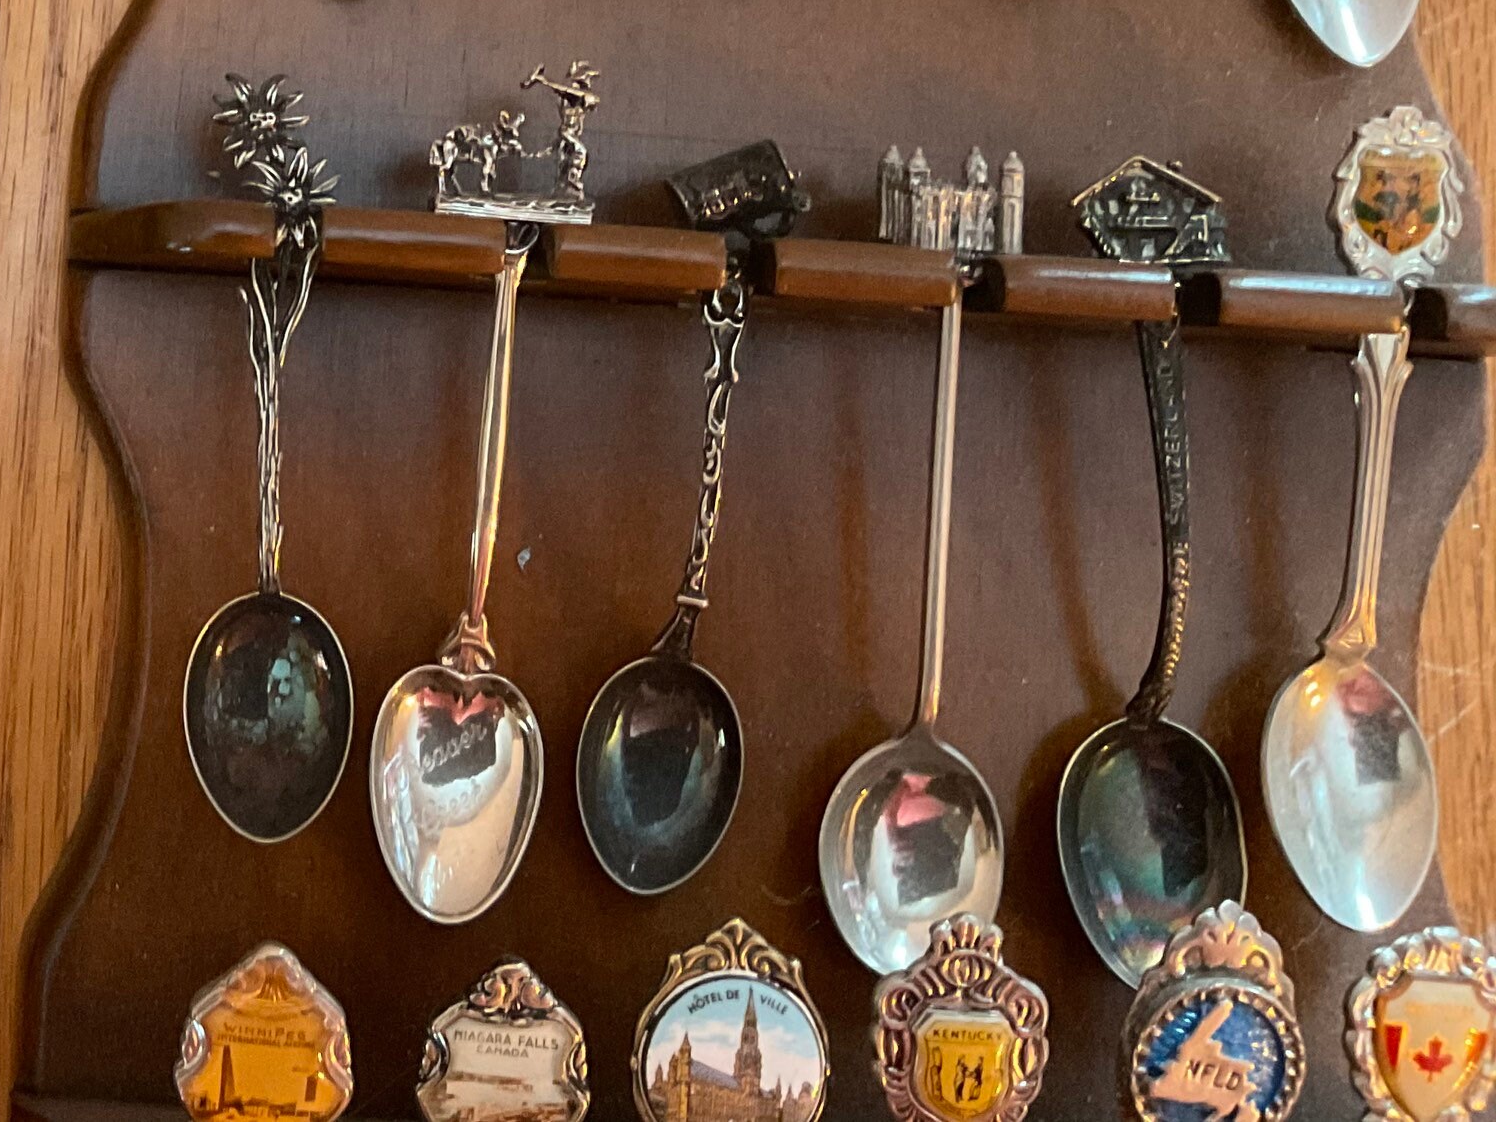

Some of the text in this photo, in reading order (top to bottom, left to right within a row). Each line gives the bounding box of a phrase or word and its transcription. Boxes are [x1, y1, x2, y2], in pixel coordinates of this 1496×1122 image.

[687, 989, 789, 1015] HÔTEL DE VILLE
[223, 1021, 307, 1040] WINNIPEG
[454, 1029, 559, 1050] NIAGARA FALLS
[932, 1028, 1003, 1041] KENTUCKY
[476, 1044, 529, 1059] CANADA
[1185, 1059, 1242, 1090] NFLD
